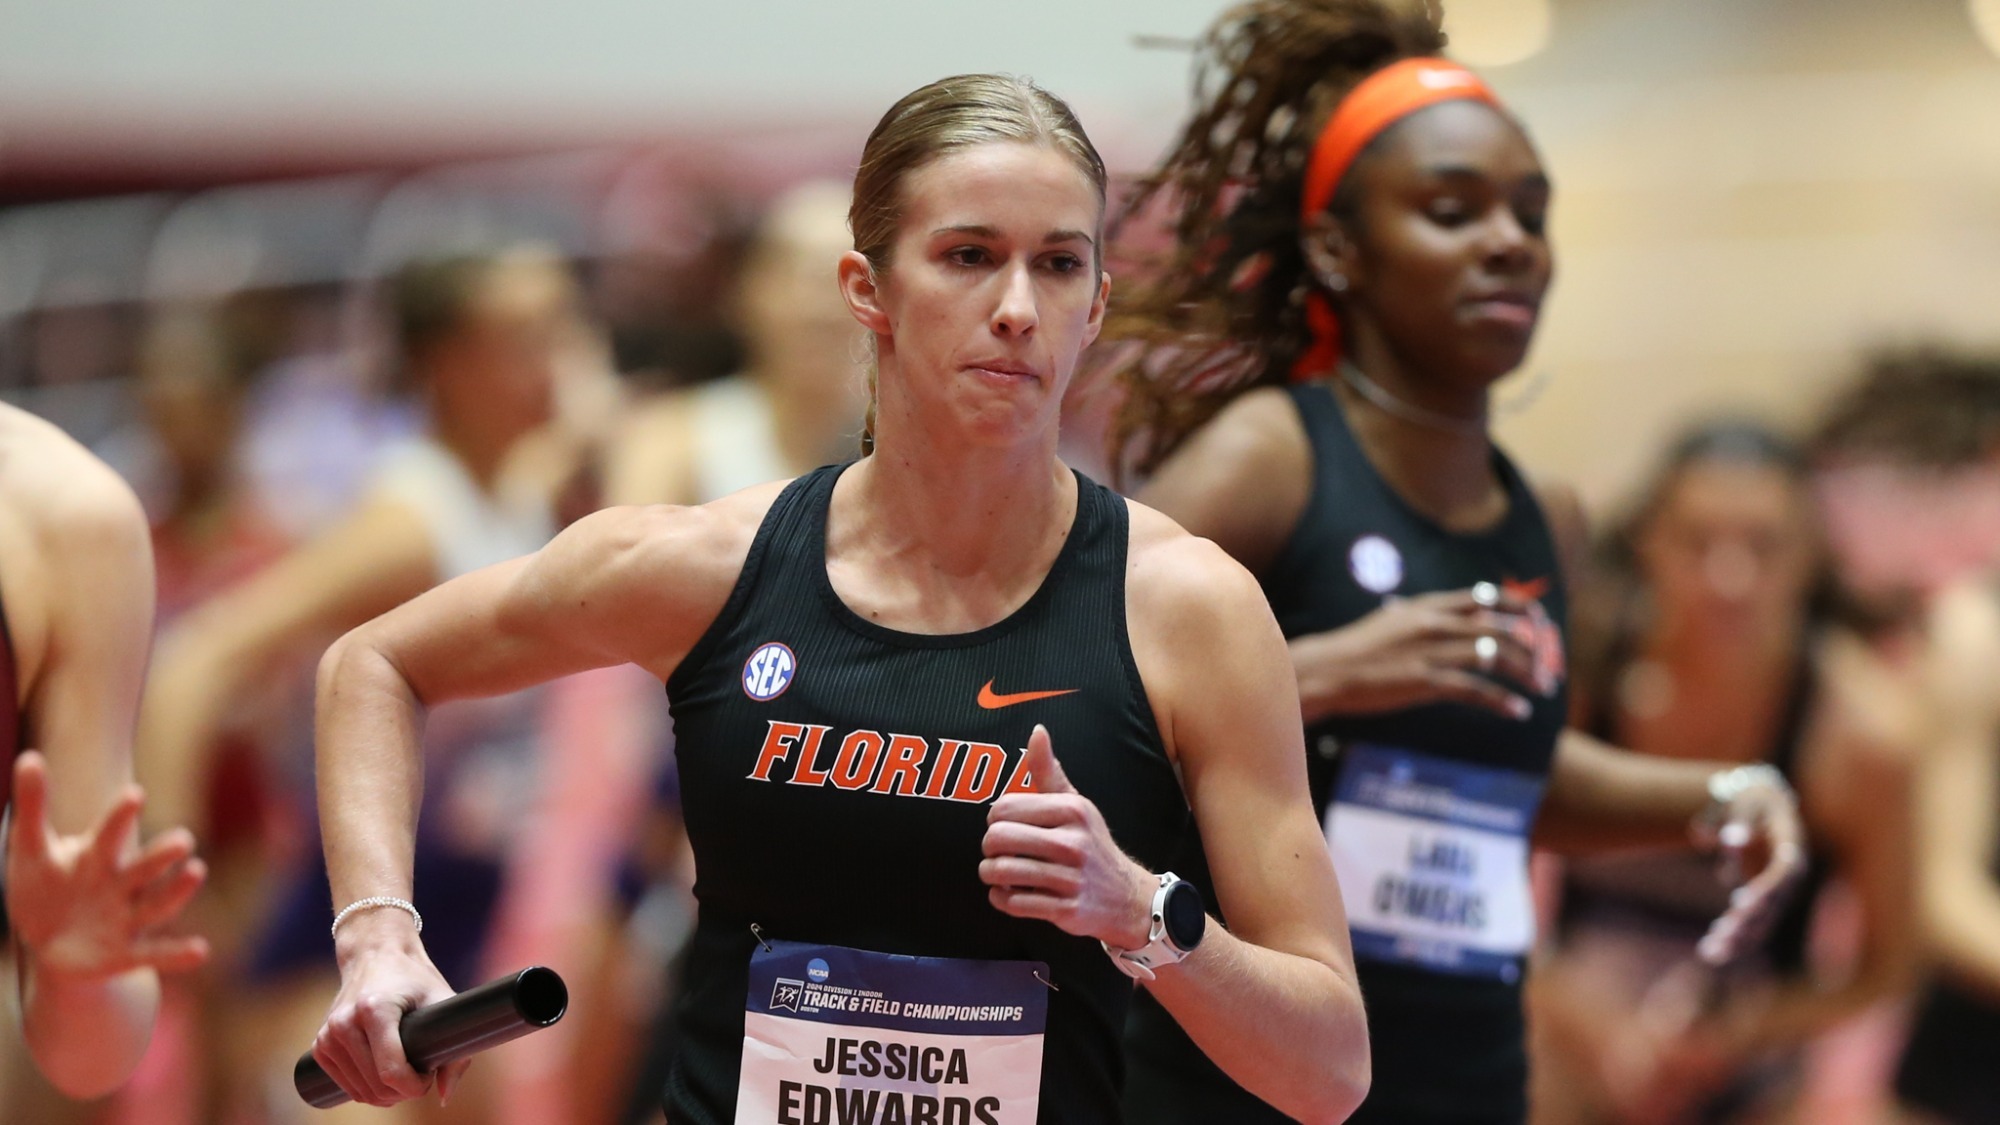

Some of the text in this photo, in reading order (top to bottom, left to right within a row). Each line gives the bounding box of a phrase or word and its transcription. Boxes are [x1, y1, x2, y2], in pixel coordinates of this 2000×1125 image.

[745, 646, 792, 697] SEC
[806, 982, 823, 991] 2024
[823, 985, 853, 996] DIVISION
[858, 990, 883, 998] INDOOR
[808, 968, 829, 978] NCAA
[804, 990, 1023, 1021] TRACK & FIELD CHAMPIONSHIPS
[813, 1037, 969, 1084] JESSICA
[777, 1080, 1001, 1125] EDWARDS
